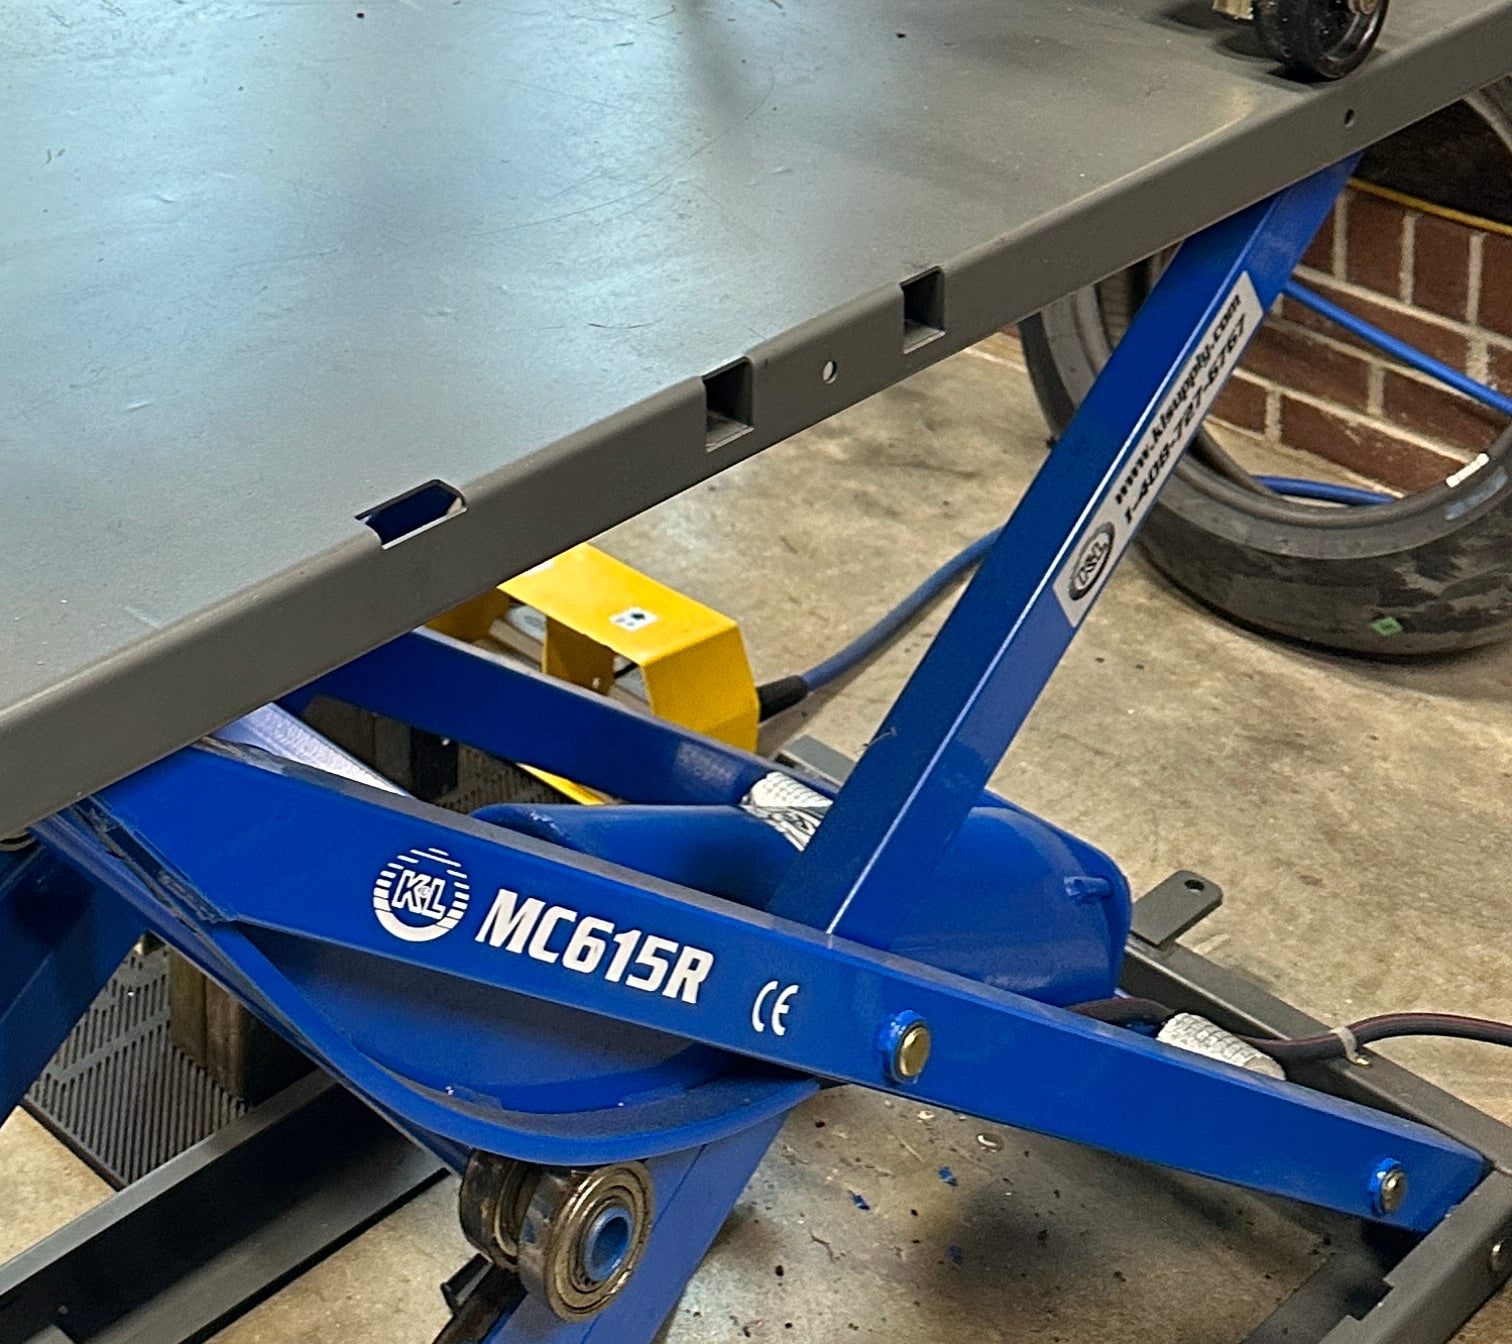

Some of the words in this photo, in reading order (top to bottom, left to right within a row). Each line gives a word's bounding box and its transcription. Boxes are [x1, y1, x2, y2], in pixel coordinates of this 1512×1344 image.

[1115, 294, 1242, 505] www.klsupply.com
[474, 887, 715, 1005] MC615R
[750, 979, 800, 1037] CE
